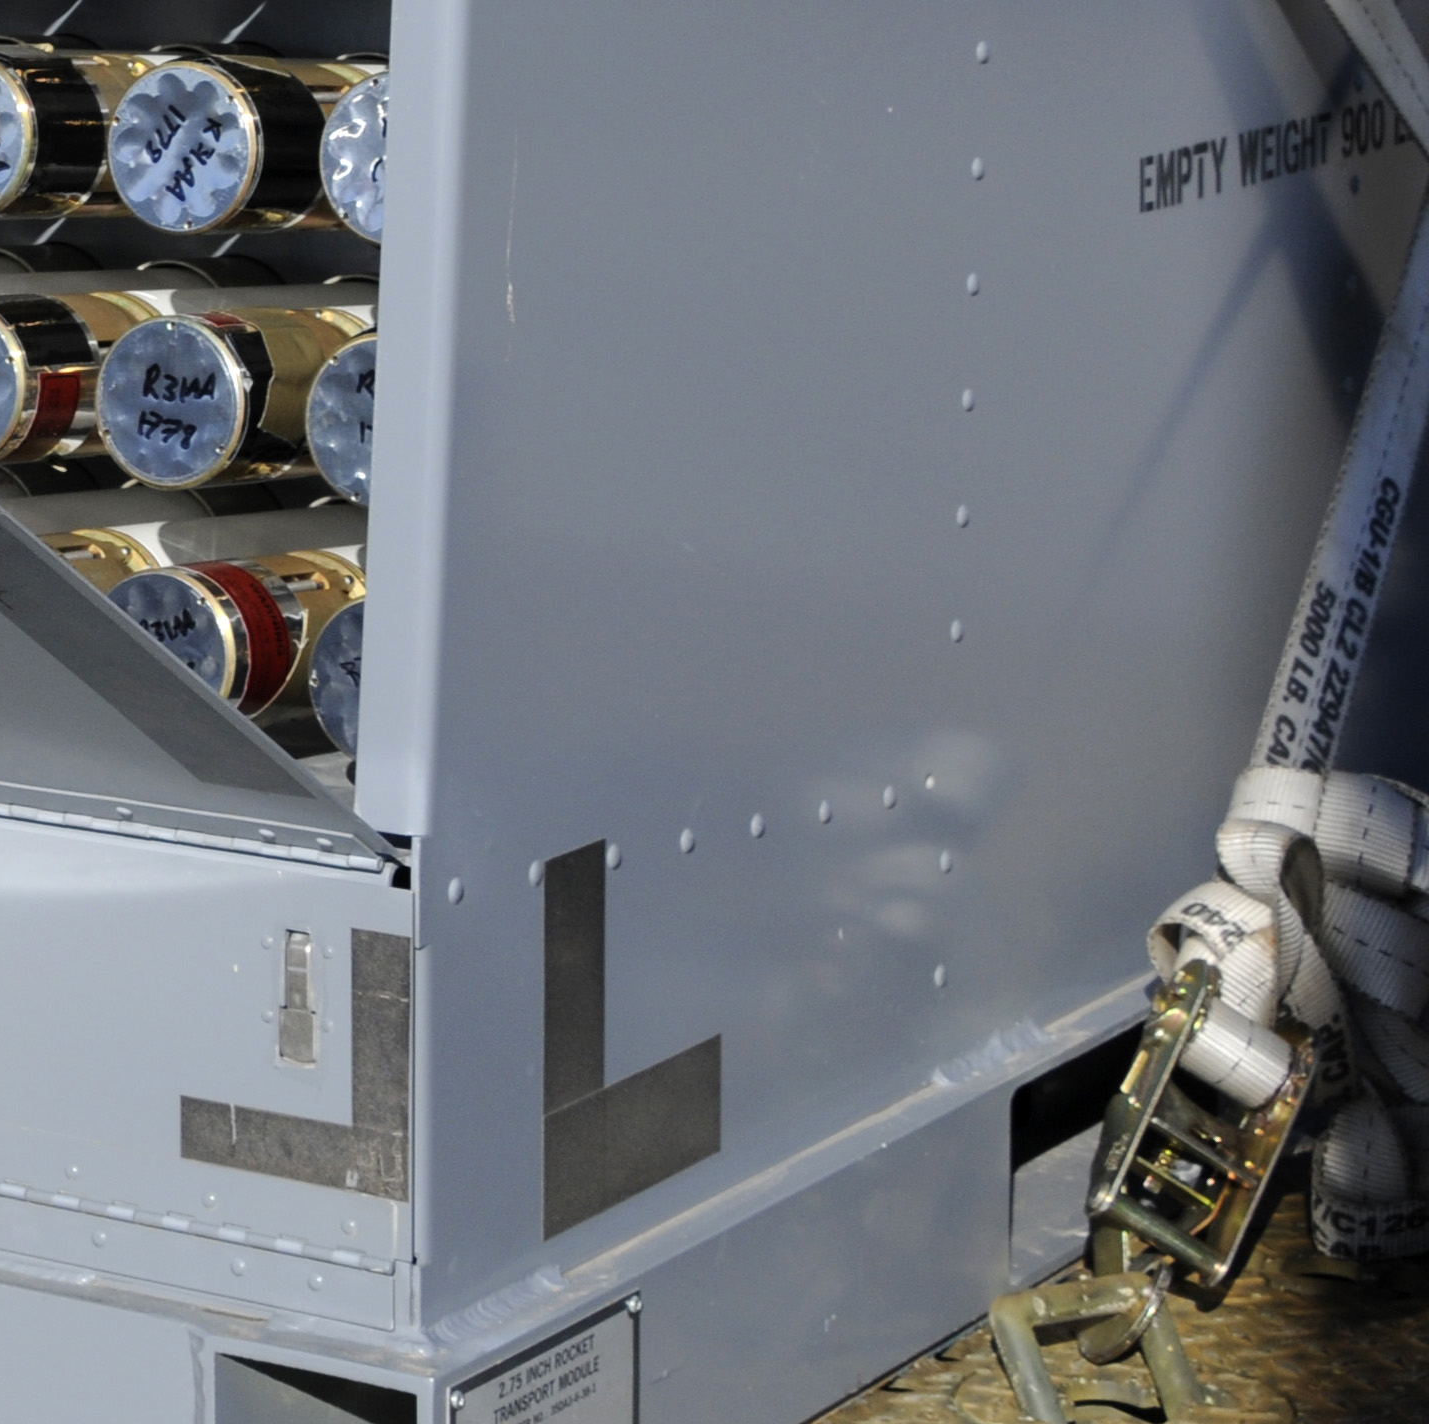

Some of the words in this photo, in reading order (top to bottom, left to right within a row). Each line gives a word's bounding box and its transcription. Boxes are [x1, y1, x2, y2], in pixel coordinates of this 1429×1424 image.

[1139, 137, 1228, 213] EMPTY
[1238, 111, 1332, 188] WEIGHT
[1341, 99, 1387, 159] 900
[1300, 581, 1337, 659] 5000
[1266, 713, 1297, 768] CA
[493, 1379, 556, 1424] TRANSPORT
[558, 1355, 600, 1392] MODULE
[526, 1357, 552, 1385] INCH
[554, 1334, 595, 1369] ROCKET
